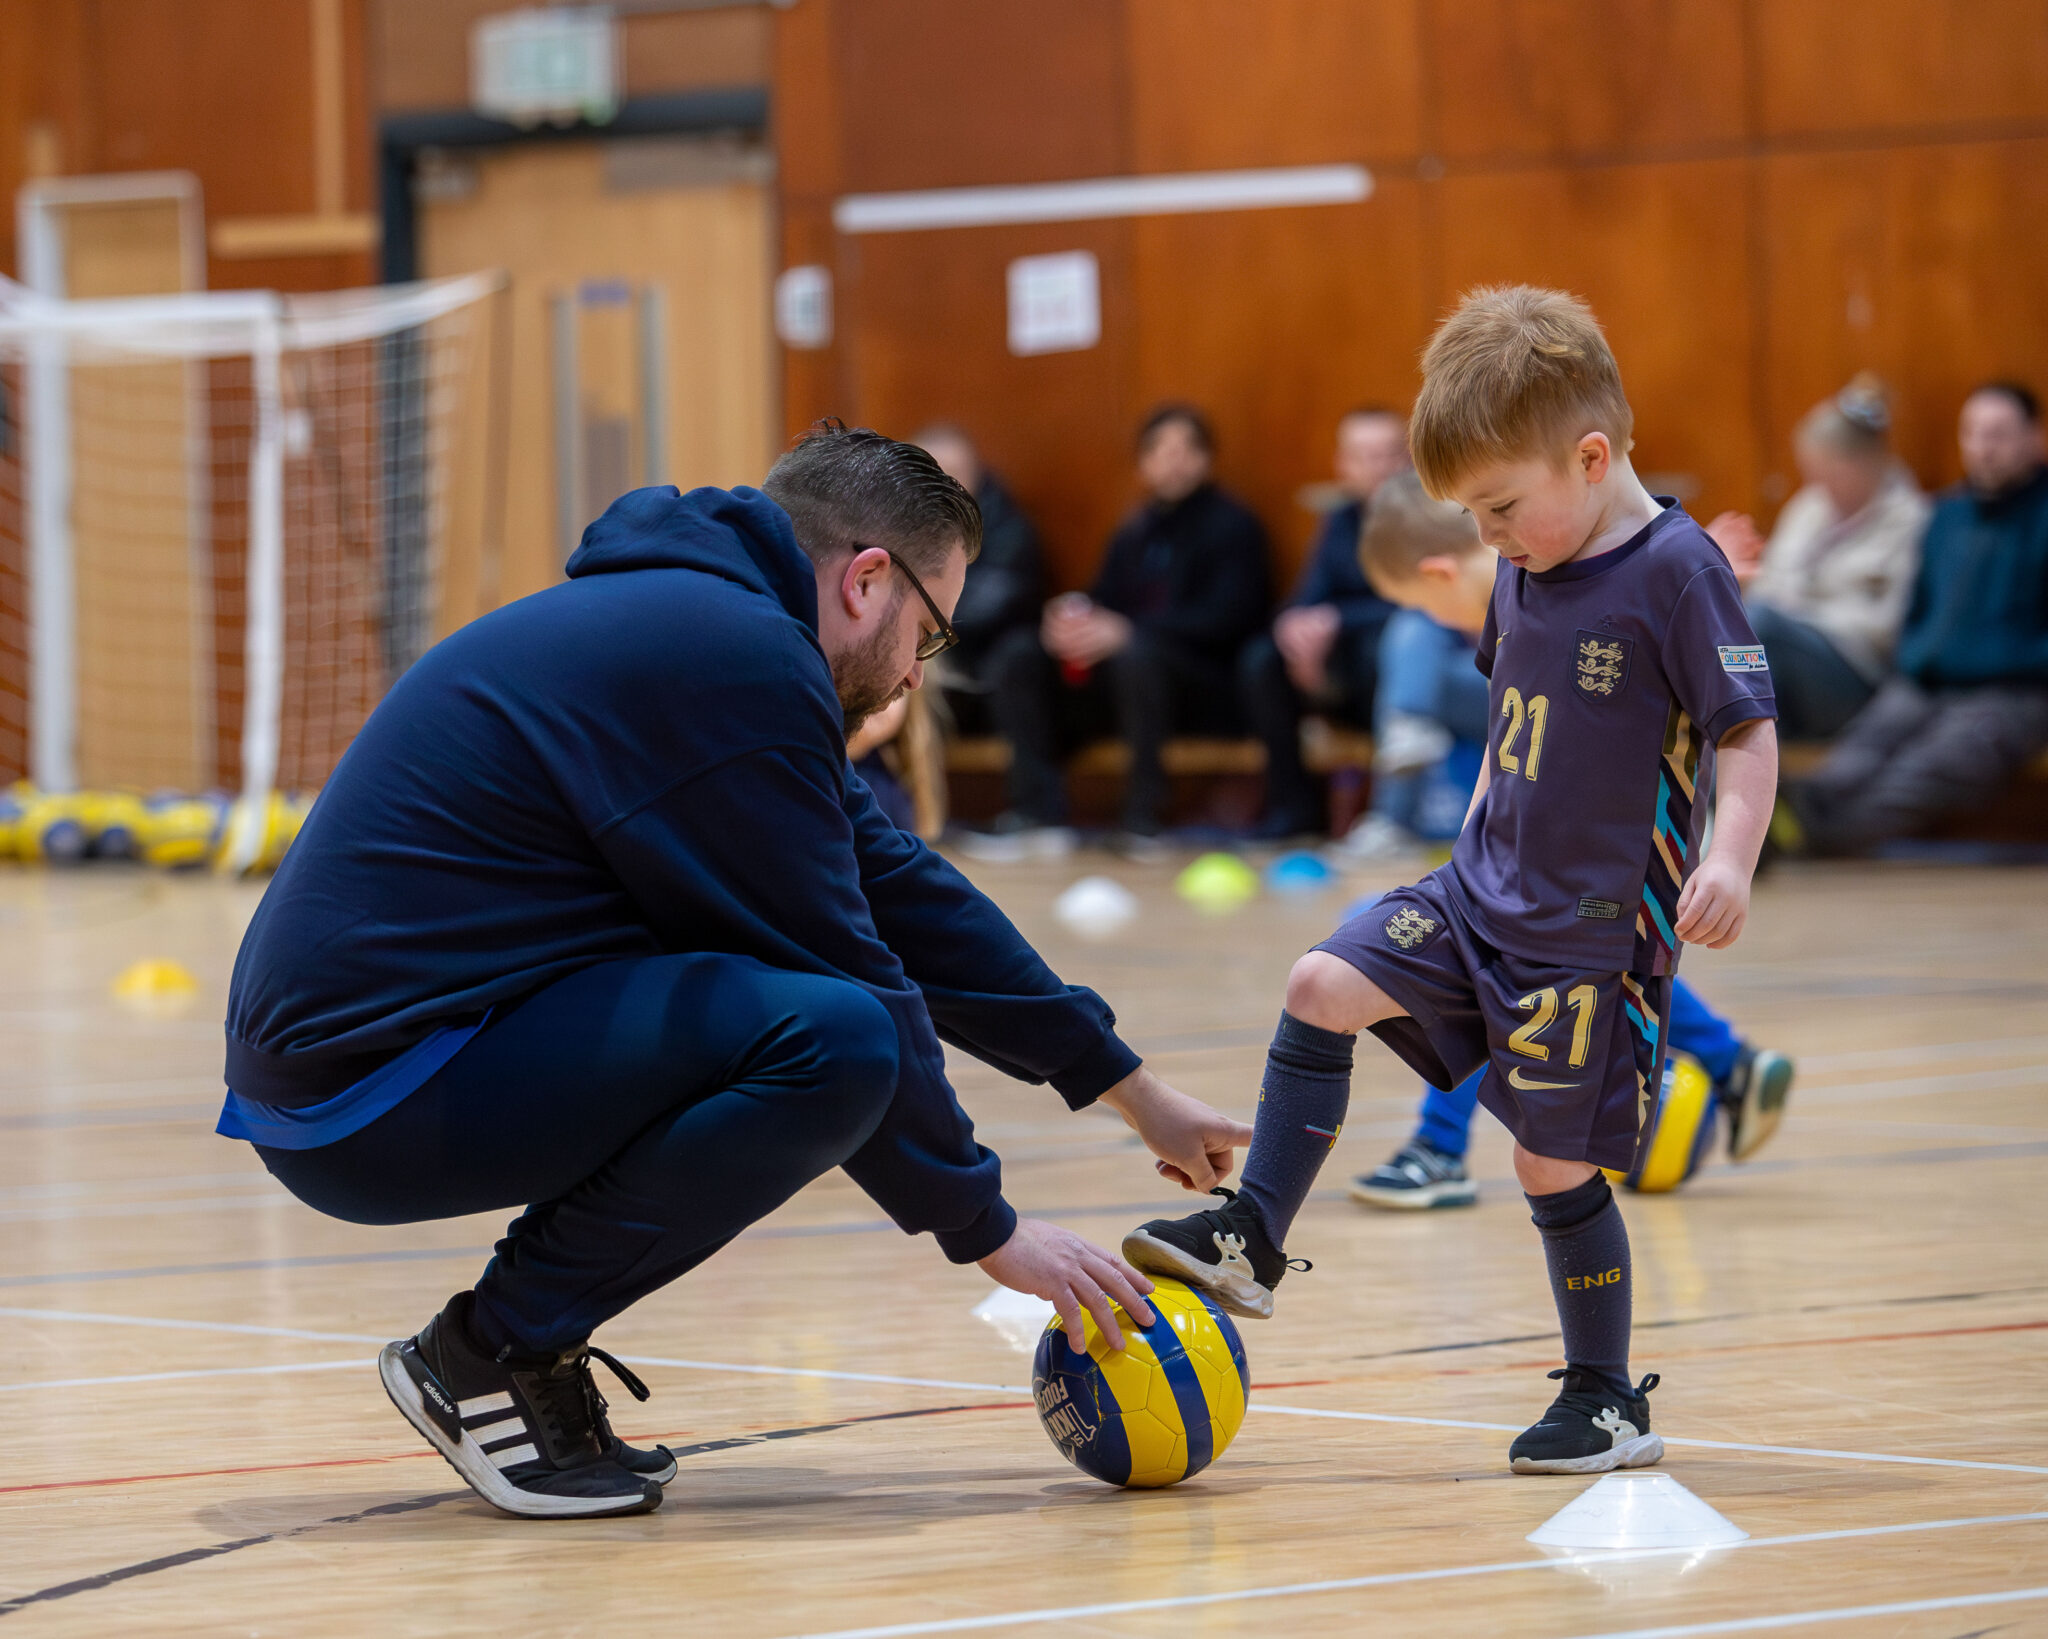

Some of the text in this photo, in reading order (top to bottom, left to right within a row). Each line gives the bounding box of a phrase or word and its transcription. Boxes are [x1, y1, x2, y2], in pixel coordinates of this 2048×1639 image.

[1720, 652, 1765, 663] FOUNDATION
[1498, 686, 1550, 782] 21
[1508, 984, 1598, 1070] 21
[1566, 1267, 1621, 1290] ENG
[423, 1381, 445, 1407] adidas
